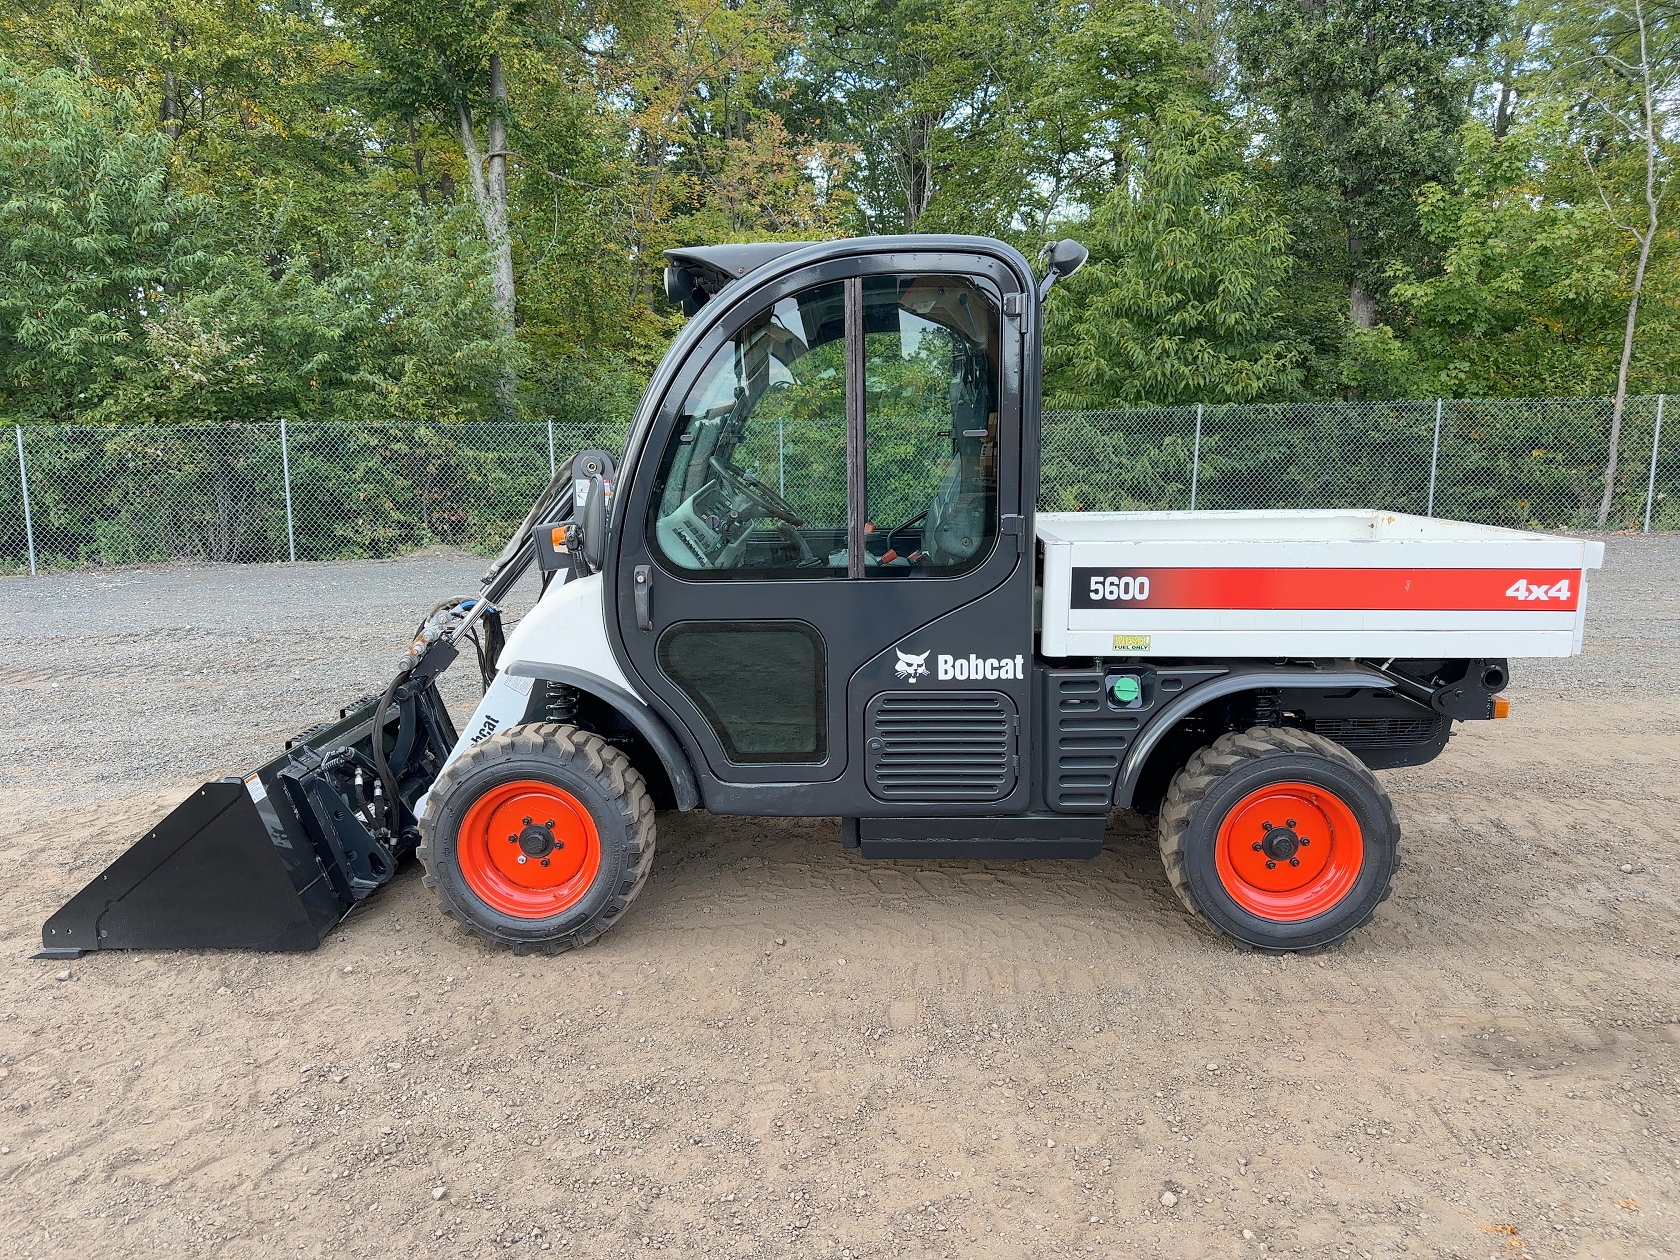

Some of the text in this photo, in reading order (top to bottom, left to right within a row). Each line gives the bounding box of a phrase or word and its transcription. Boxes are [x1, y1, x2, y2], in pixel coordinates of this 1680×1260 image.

[1089, 576, 1150, 601] 5600
[1505, 579, 1571, 601] 4x4
[938, 654, 1024, 680] Bobcat
